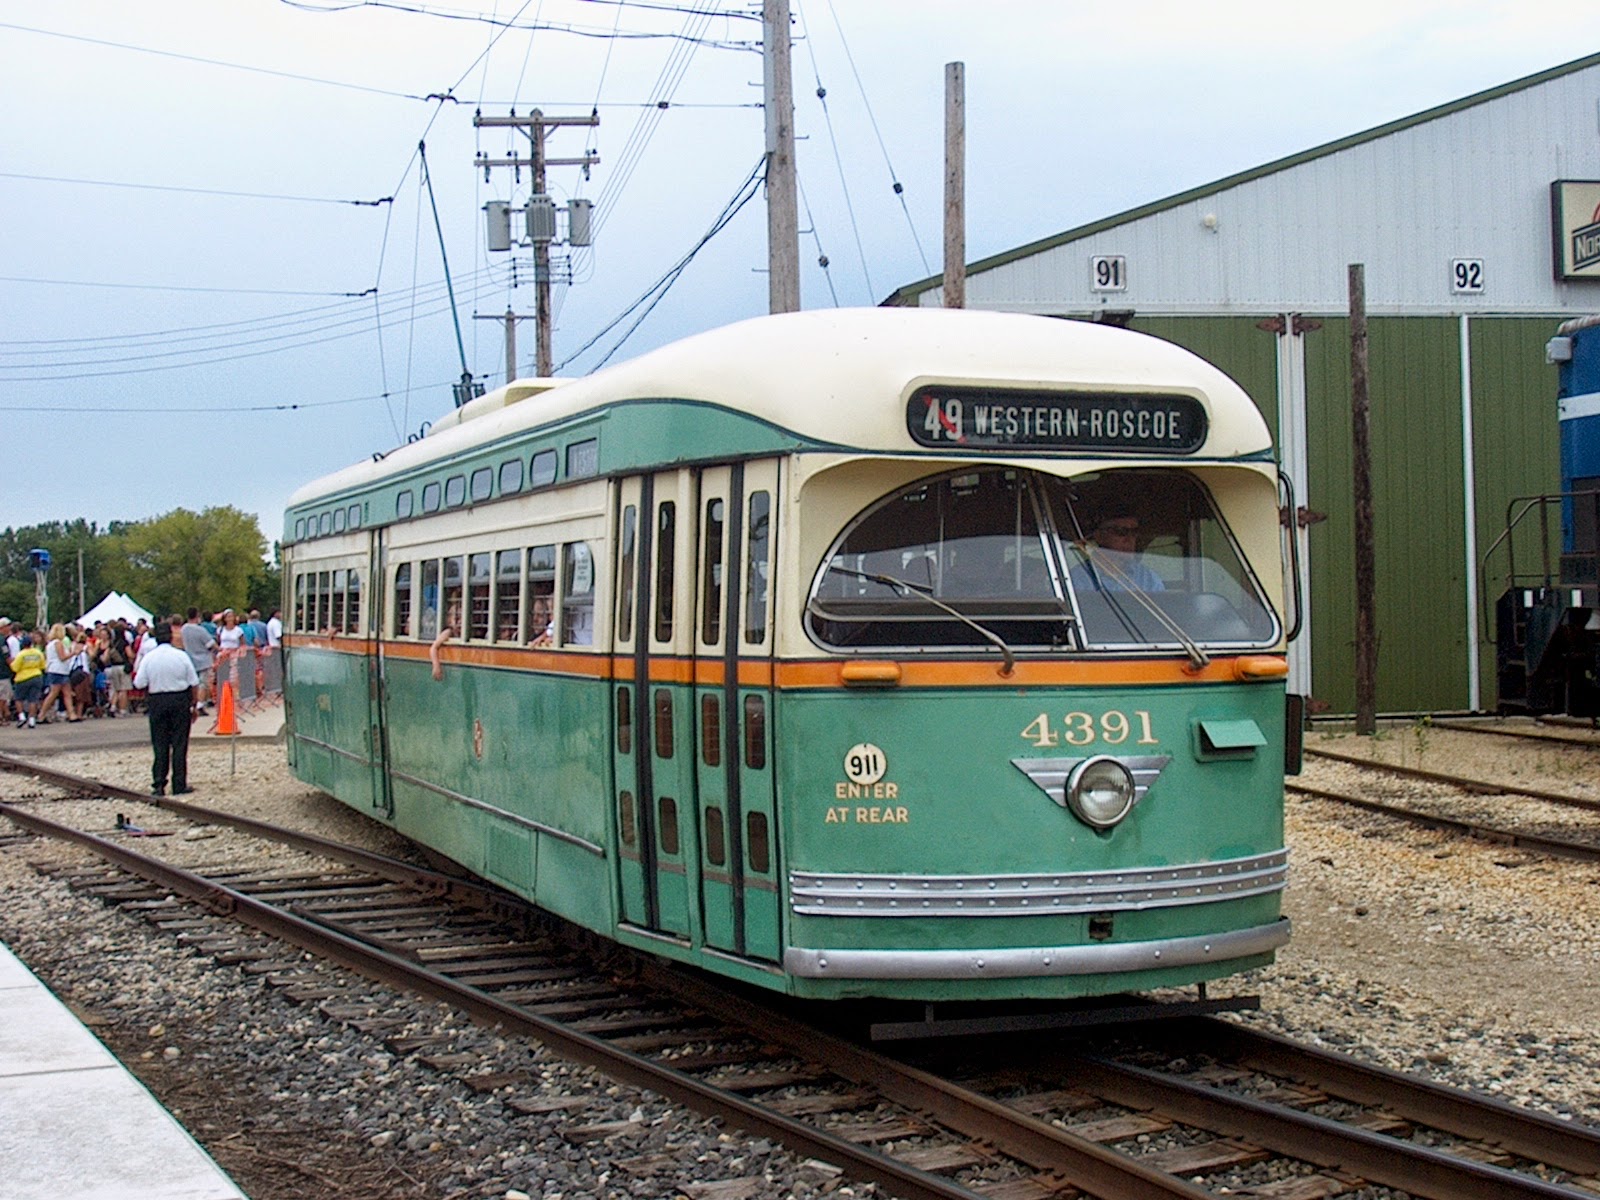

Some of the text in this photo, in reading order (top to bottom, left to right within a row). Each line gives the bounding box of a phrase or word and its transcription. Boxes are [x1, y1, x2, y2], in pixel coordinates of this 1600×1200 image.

[1097, 259, 1119, 286] 91
[1455, 262, 1481, 288] 92
[924, 398, 1181, 440] 49 WESTERN-ROSCOE
[1020, 710, 1158, 747] 4391
[850, 754, 878, 776] 911
[835, 782, 898, 799] ENTER
[825, 806, 909, 823] AT REAR
